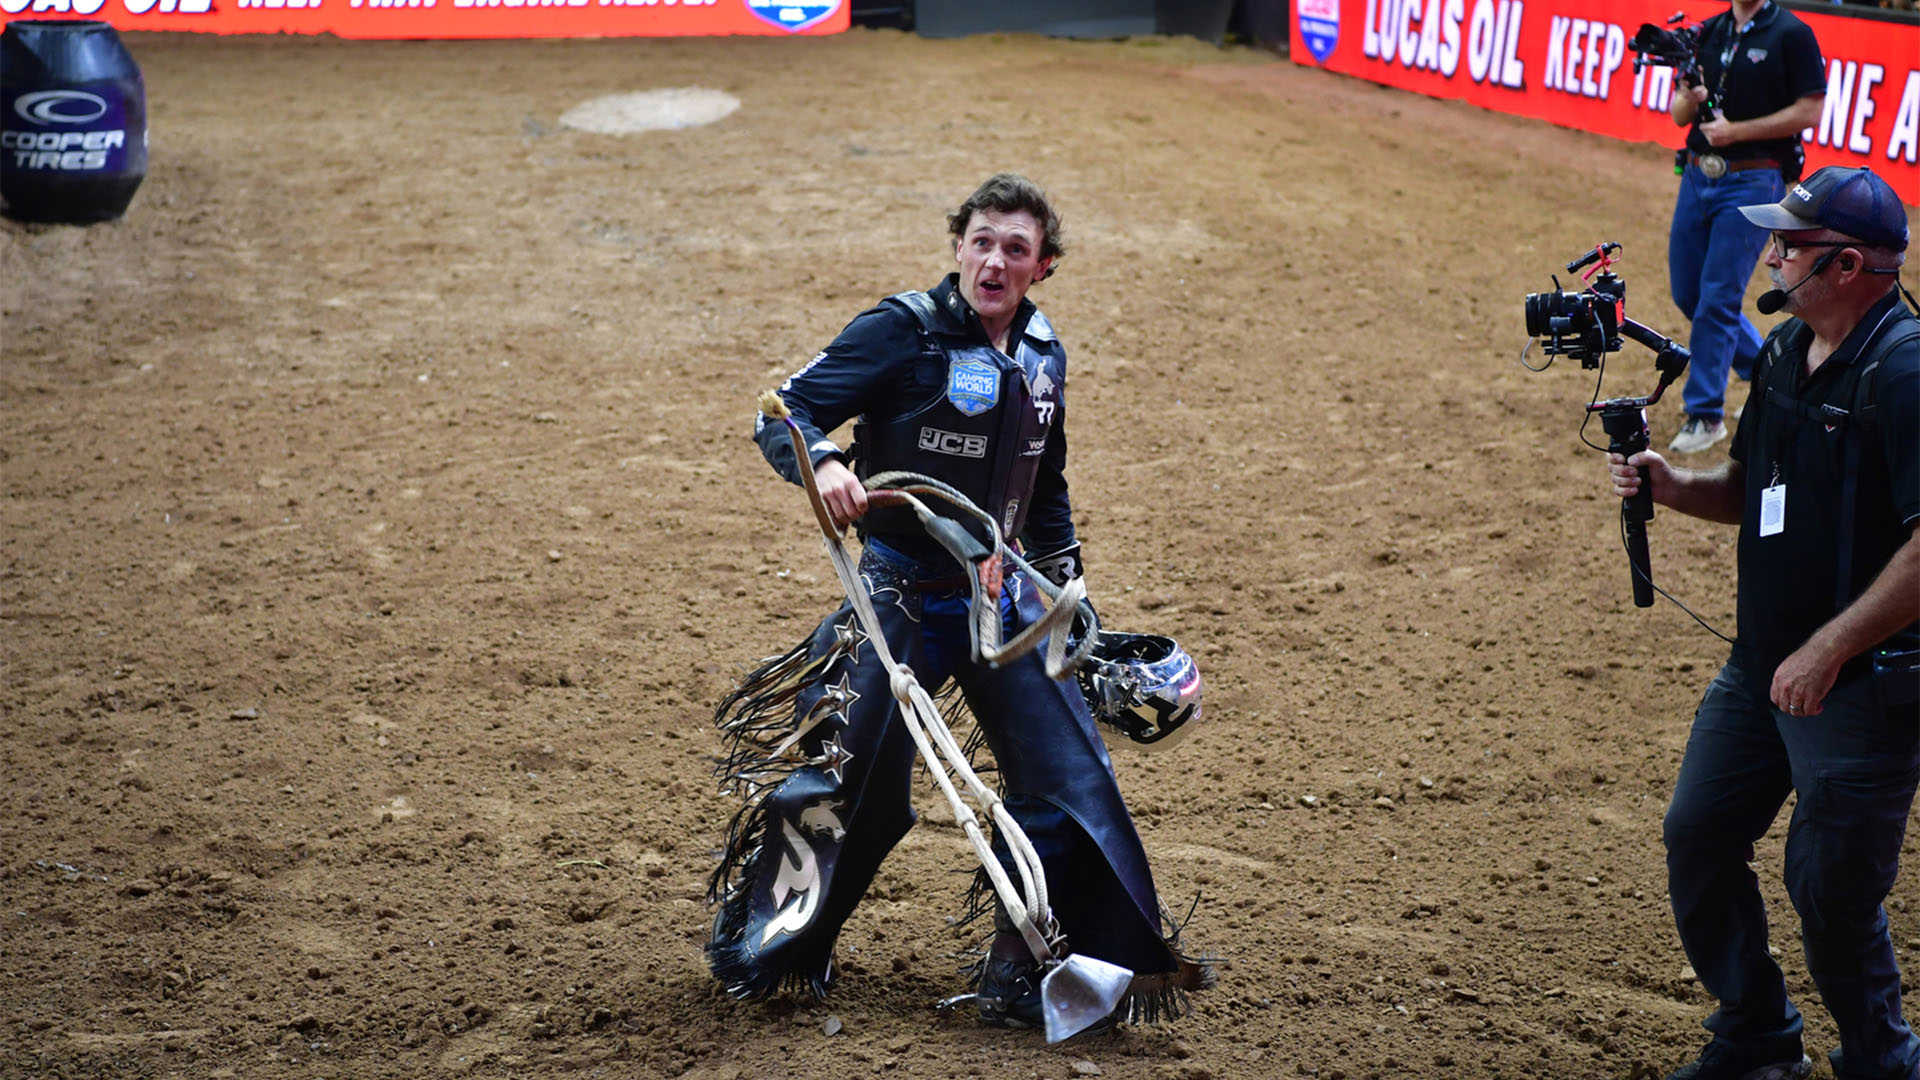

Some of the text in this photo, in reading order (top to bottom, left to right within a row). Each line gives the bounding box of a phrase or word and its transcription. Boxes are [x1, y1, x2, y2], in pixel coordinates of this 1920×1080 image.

[1363, 0, 1465, 77] LUCAS
[1467, 0, 1525, 88] OIL
[1544, 15, 1626, 100] KEEP
[2, 130, 125, 150] COOPER
[15, 151, 107, 169] TIRES
[955, 371, 994, 386] CAMPING
[955, 380, 993, 395] WORLD
[922, 430, 985, 455] JCB
